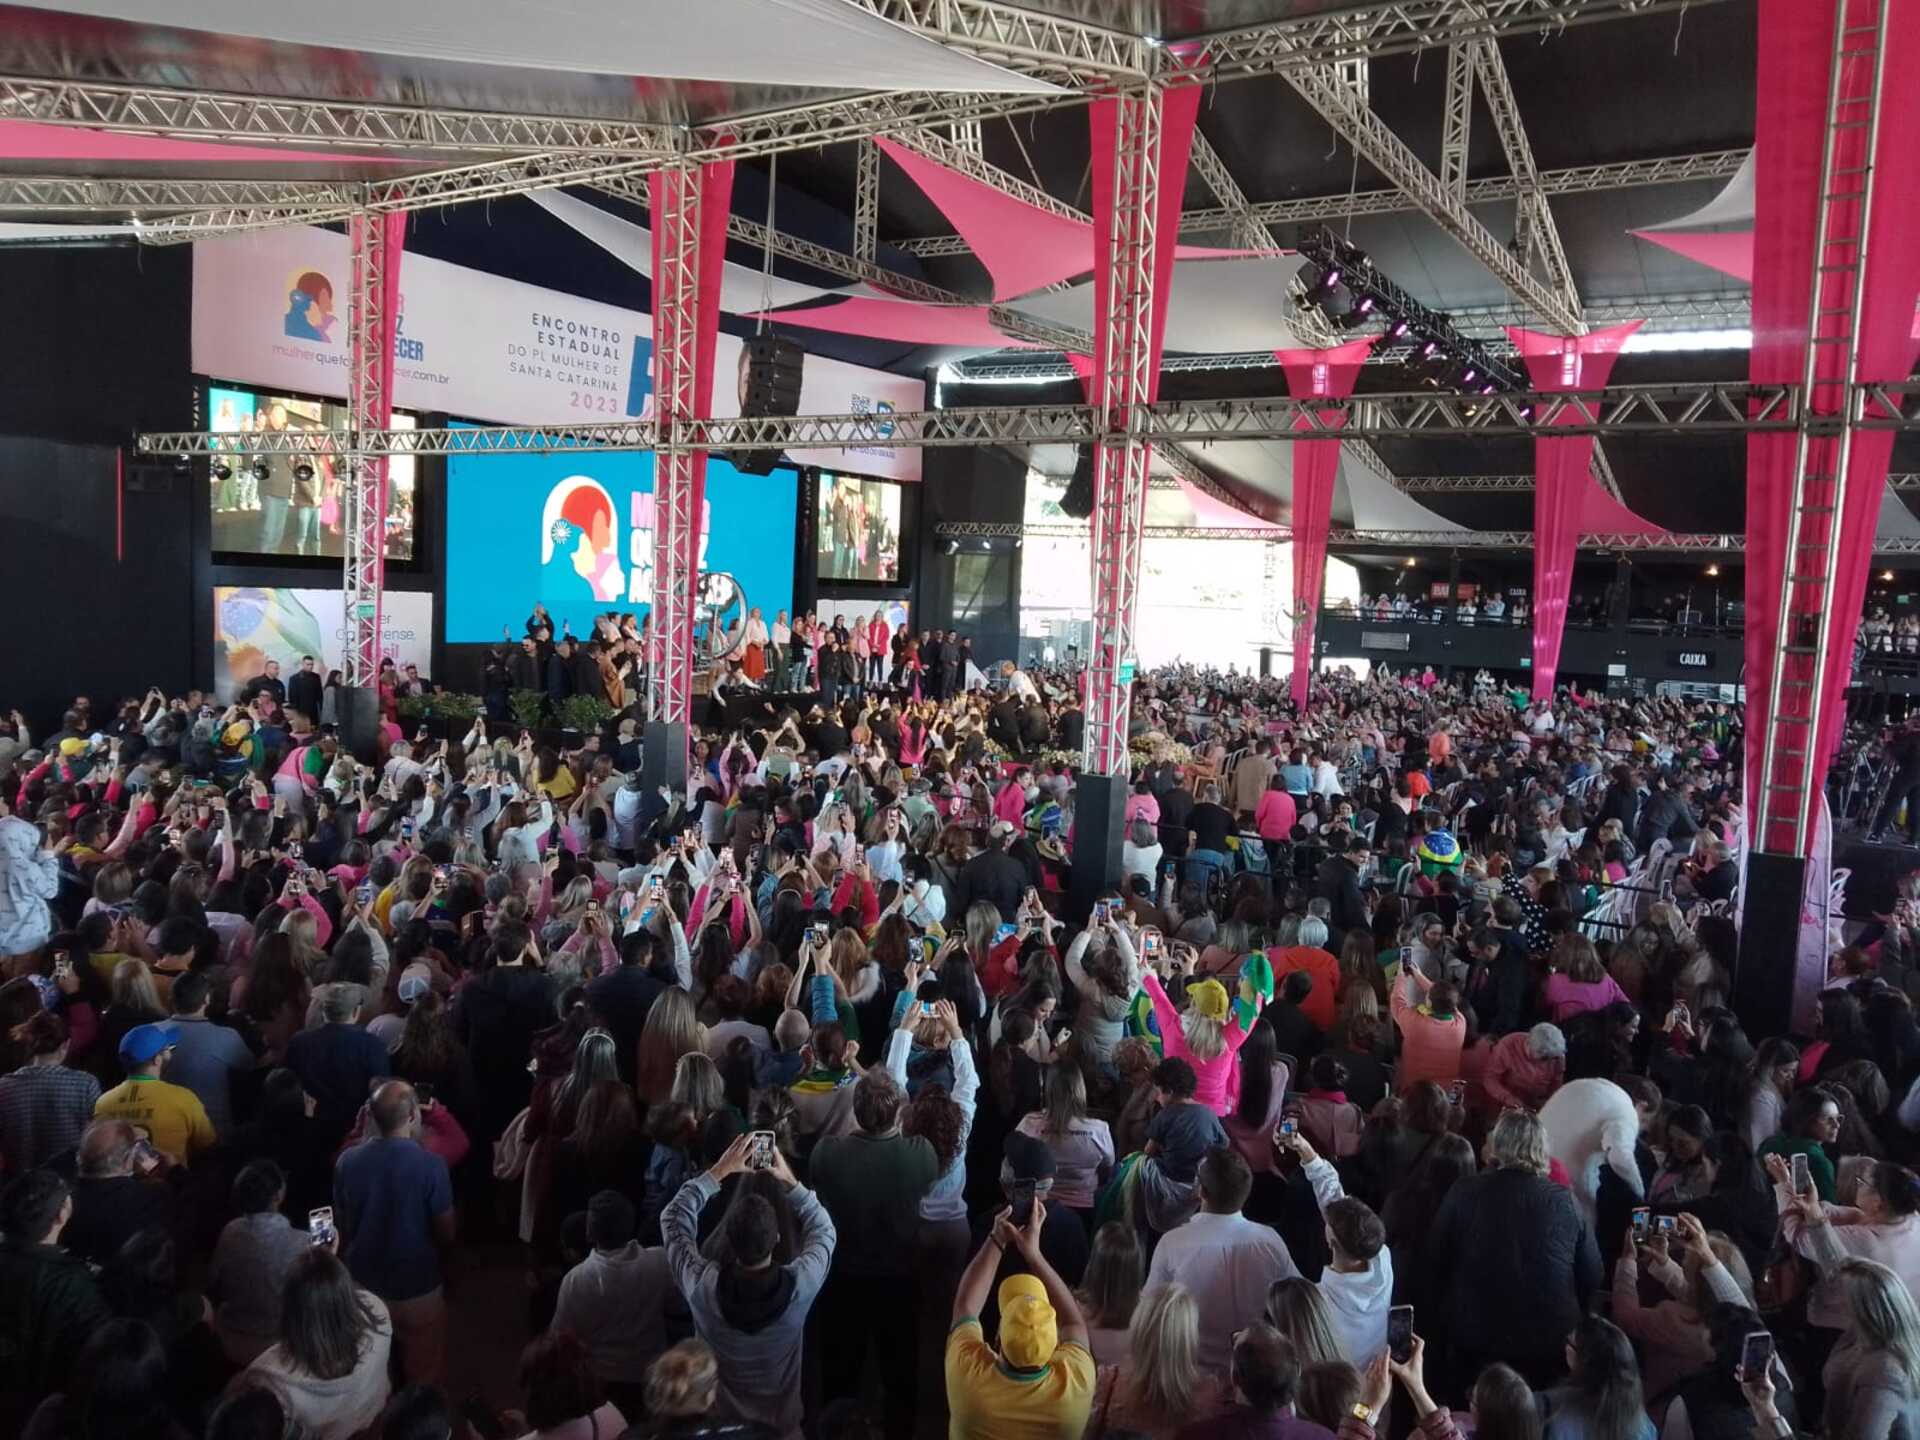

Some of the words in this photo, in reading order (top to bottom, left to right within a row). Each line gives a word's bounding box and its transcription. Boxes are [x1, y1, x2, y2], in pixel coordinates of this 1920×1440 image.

[531, 313, 621, 344] ENCONTRO
[507, 343, 527, 357] DO
[532, 348, 546, 361] PL
[551, 353, 601, 373] MULHER
[604, 364, 618, 376] DE
[537, 331, 621, 360] ESTADUAL
[509, 361, 552, 380] SANTA
[557, 371, 618, 392] CATARINA
[570, 391, 618, 414] 2023
[1679, 652, 1707, 667] CAIXA
